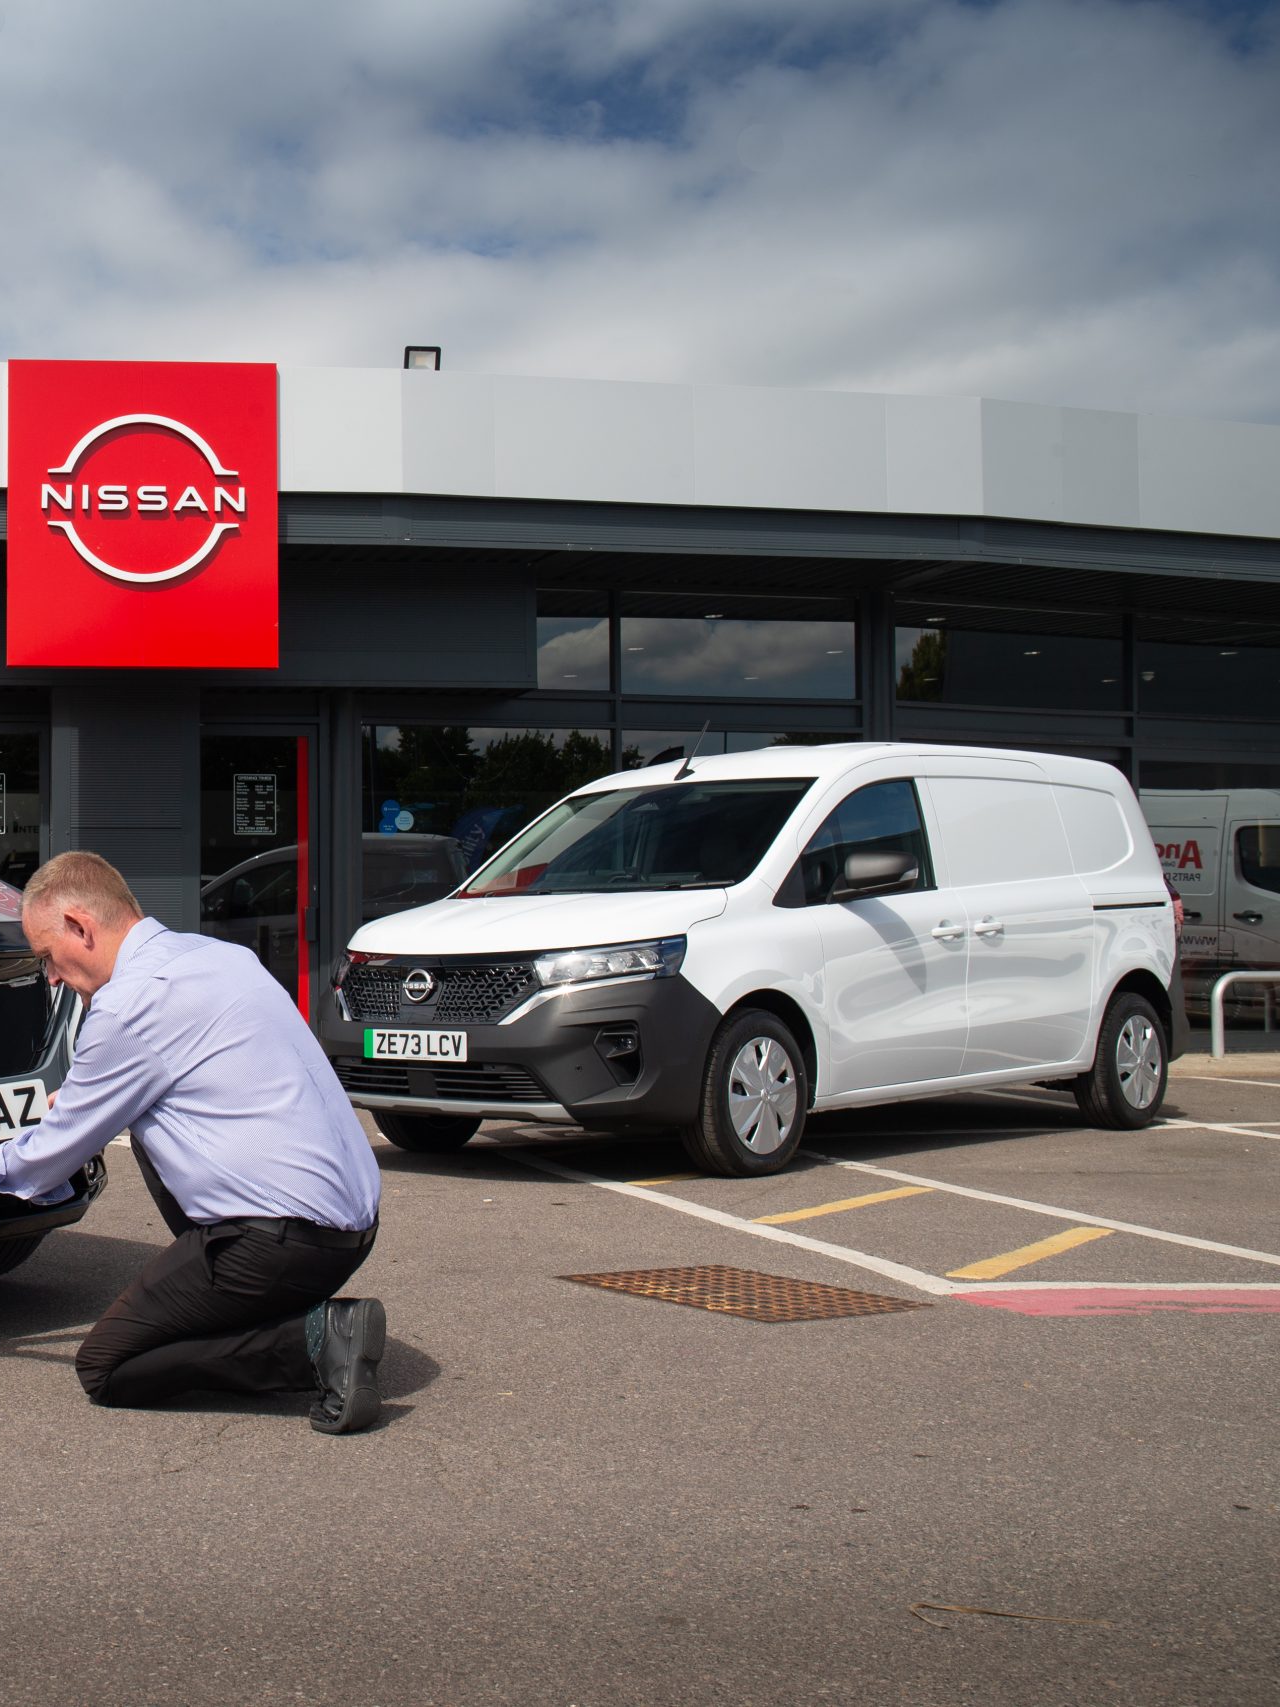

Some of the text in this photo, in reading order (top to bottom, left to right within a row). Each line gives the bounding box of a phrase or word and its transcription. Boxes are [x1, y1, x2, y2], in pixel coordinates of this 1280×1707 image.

[41, 483, 246, 513] NISSAN
[402, 981, 434, 990] NISSAN
[376, 1033, 462, 1057] ZE73 LCV
